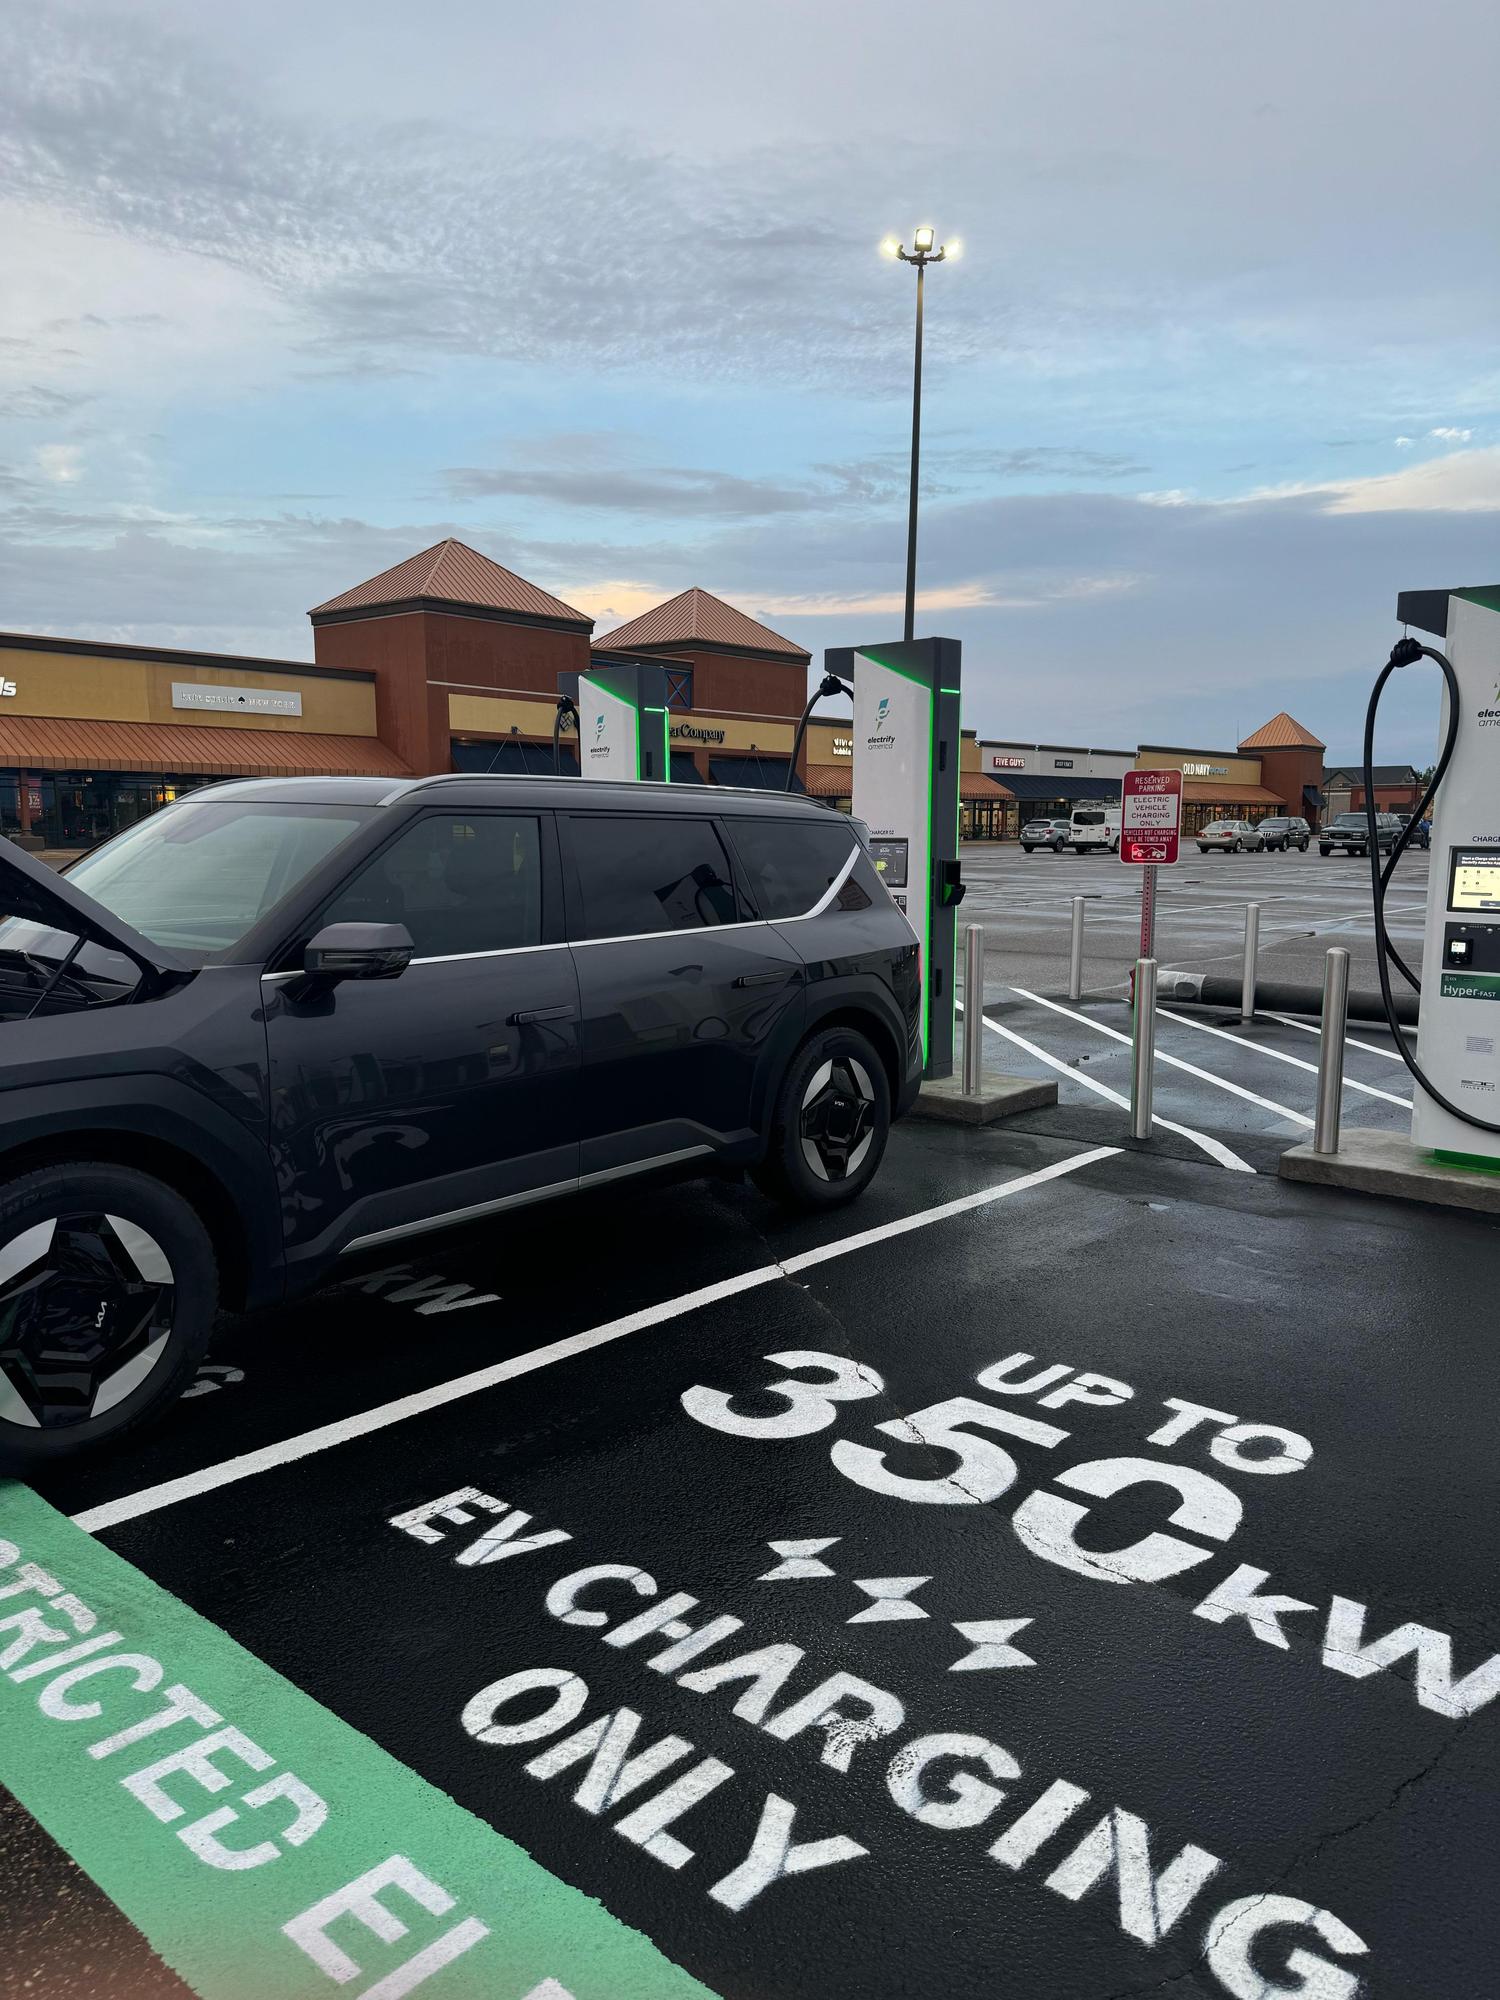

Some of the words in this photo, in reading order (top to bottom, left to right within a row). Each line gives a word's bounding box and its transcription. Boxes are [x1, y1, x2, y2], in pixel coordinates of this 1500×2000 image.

[680, 723, 725, 743] Company
[867, 735, 895, 744] electrify
[995, 757, 1009, 767] FIVE
[1009, 758, 1025, 768] GUYS
[1183, 763, 1195, 775] OLD
[1195, 764, 1210, 776] NAVY
[1135, 776, 1170, 785] RESERVED
[1138, 784, 1166, 792] PARKING
[1133, 796, 1170, 804] ELECTRIC
[975, 1351, 1135, 1409] UP
[1146, 1397, 1314, 1475] TO
[679, 1349, 1244, 1584] 350
[387, 1486, 574, 1566] EV
[545, 1563, 1370, 2000] CHARGING
[460, 1667, 870, 1912] ONLY
